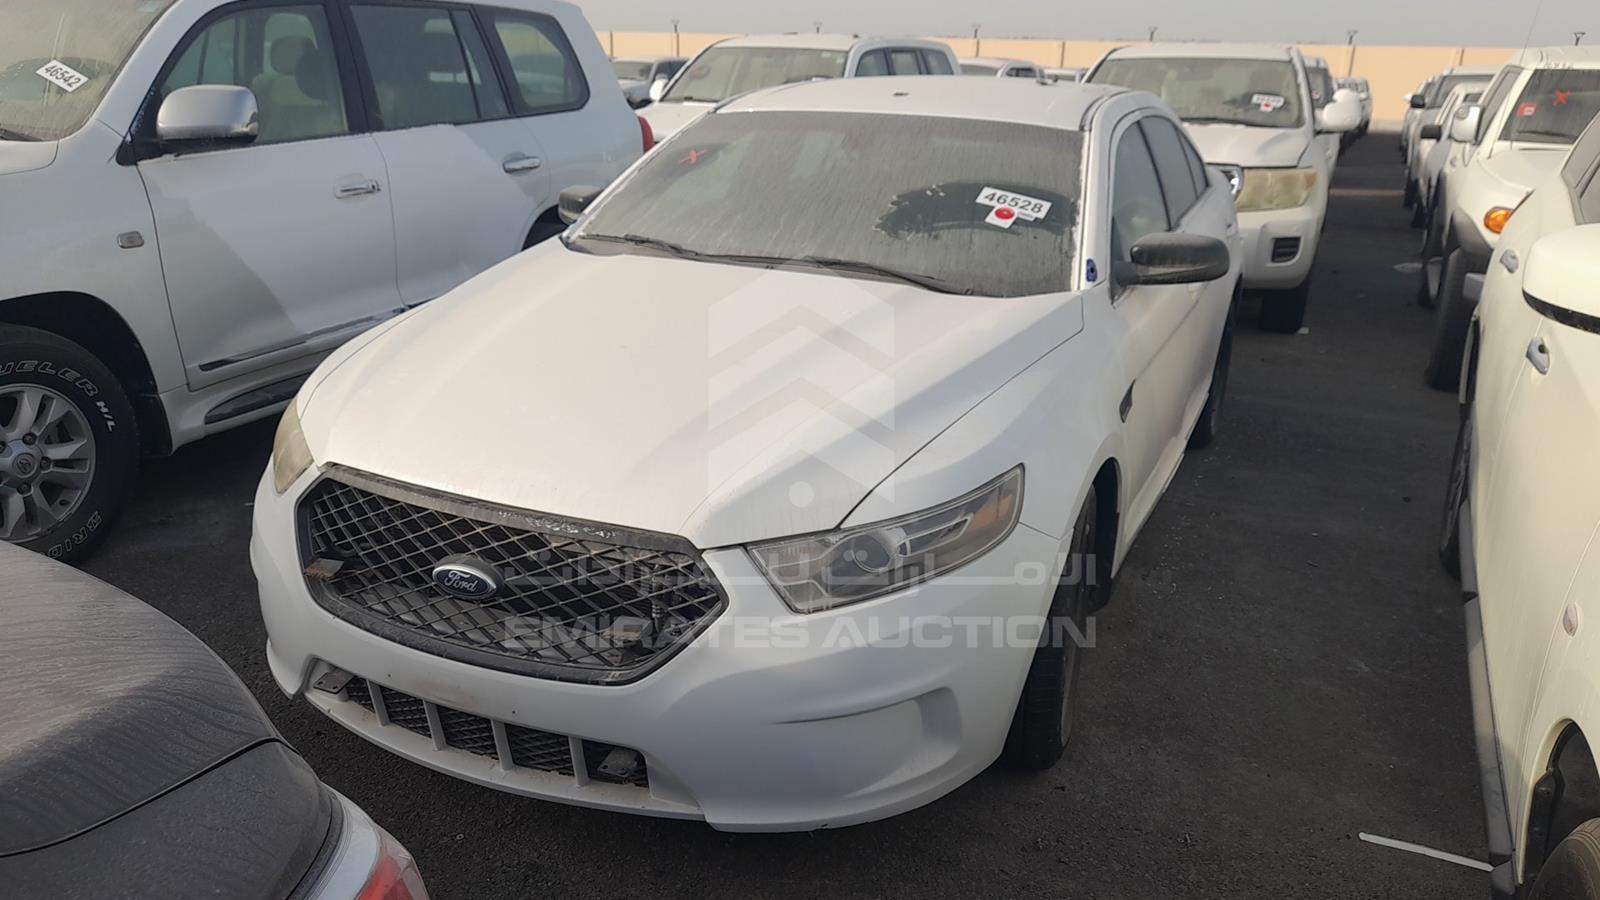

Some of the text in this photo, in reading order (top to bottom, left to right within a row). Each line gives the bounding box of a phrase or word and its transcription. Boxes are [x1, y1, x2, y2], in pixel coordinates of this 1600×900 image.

[45, 65, 81, 88] 46542
[984, 192, 1044, 213] 46528
[444, 570, 479, 592] Ford
